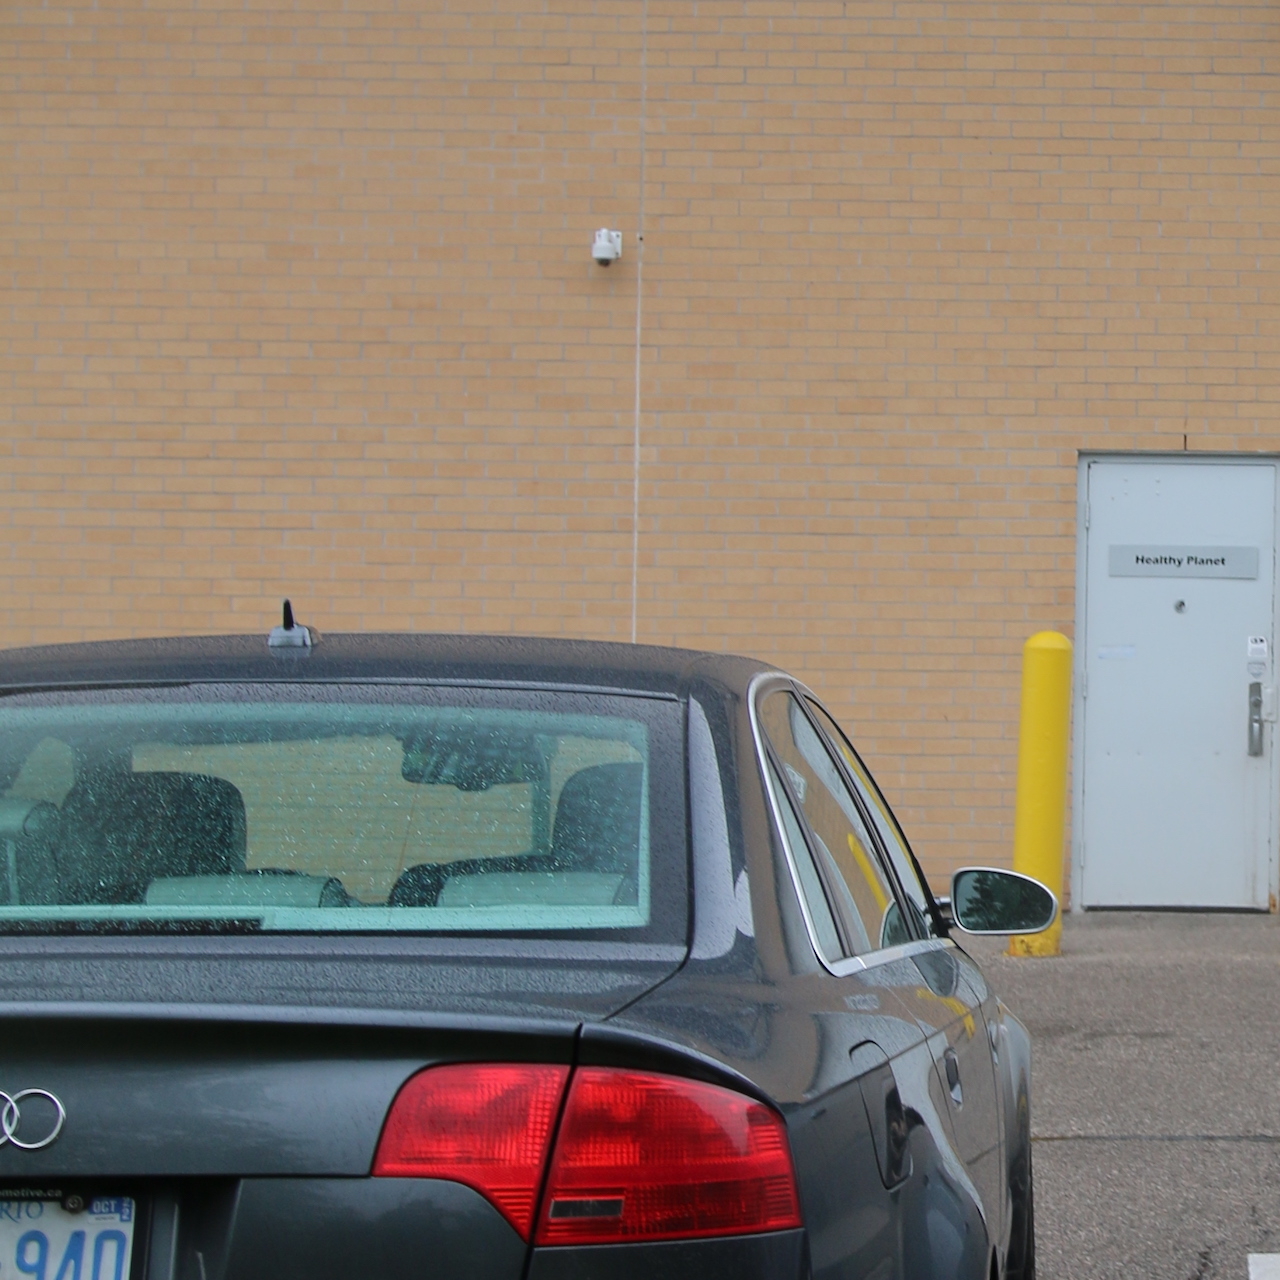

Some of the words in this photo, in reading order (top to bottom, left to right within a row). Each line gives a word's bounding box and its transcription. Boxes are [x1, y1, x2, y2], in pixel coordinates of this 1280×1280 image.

[1135, 555, 1183, 567] Healthy
[1187, 555, 1226, 566] Planet
[0, 1188, 63, 1198] motive.ca
[93, 1200, 117, 1214] OCT
